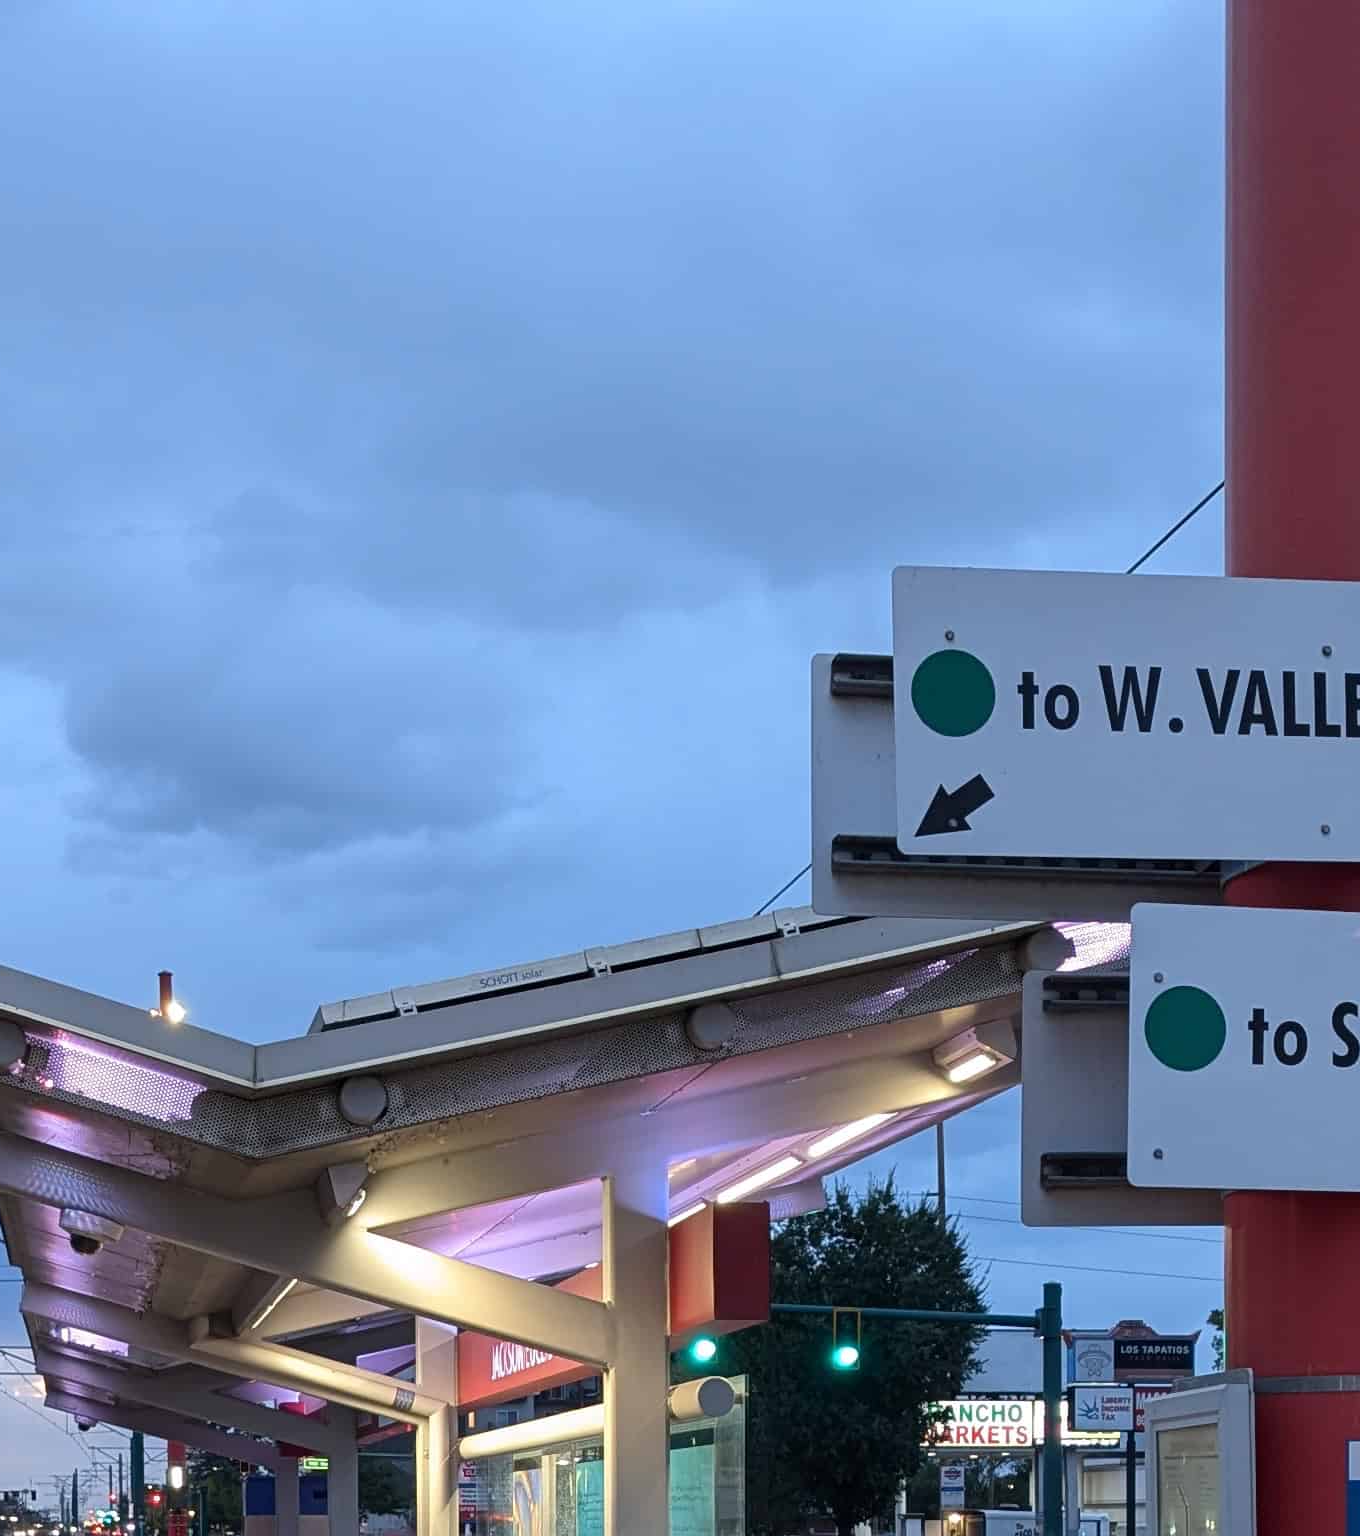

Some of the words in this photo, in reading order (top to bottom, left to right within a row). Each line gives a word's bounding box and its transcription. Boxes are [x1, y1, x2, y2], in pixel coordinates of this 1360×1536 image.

[1017, 671, 1079, 730] to
[1098, 664, 1183, 733] W.
[480, 972, 518, 988] SCHOTT
[521, 967, 544, 979] solar
[1248, 1007, 1307, 1065] to
[1120, 1345, 1140, 1354] LOS
[1141, 1345, 1189, 1354] TAPATIOS
[1101, 1396, 1131, 1404] LIBERTY
